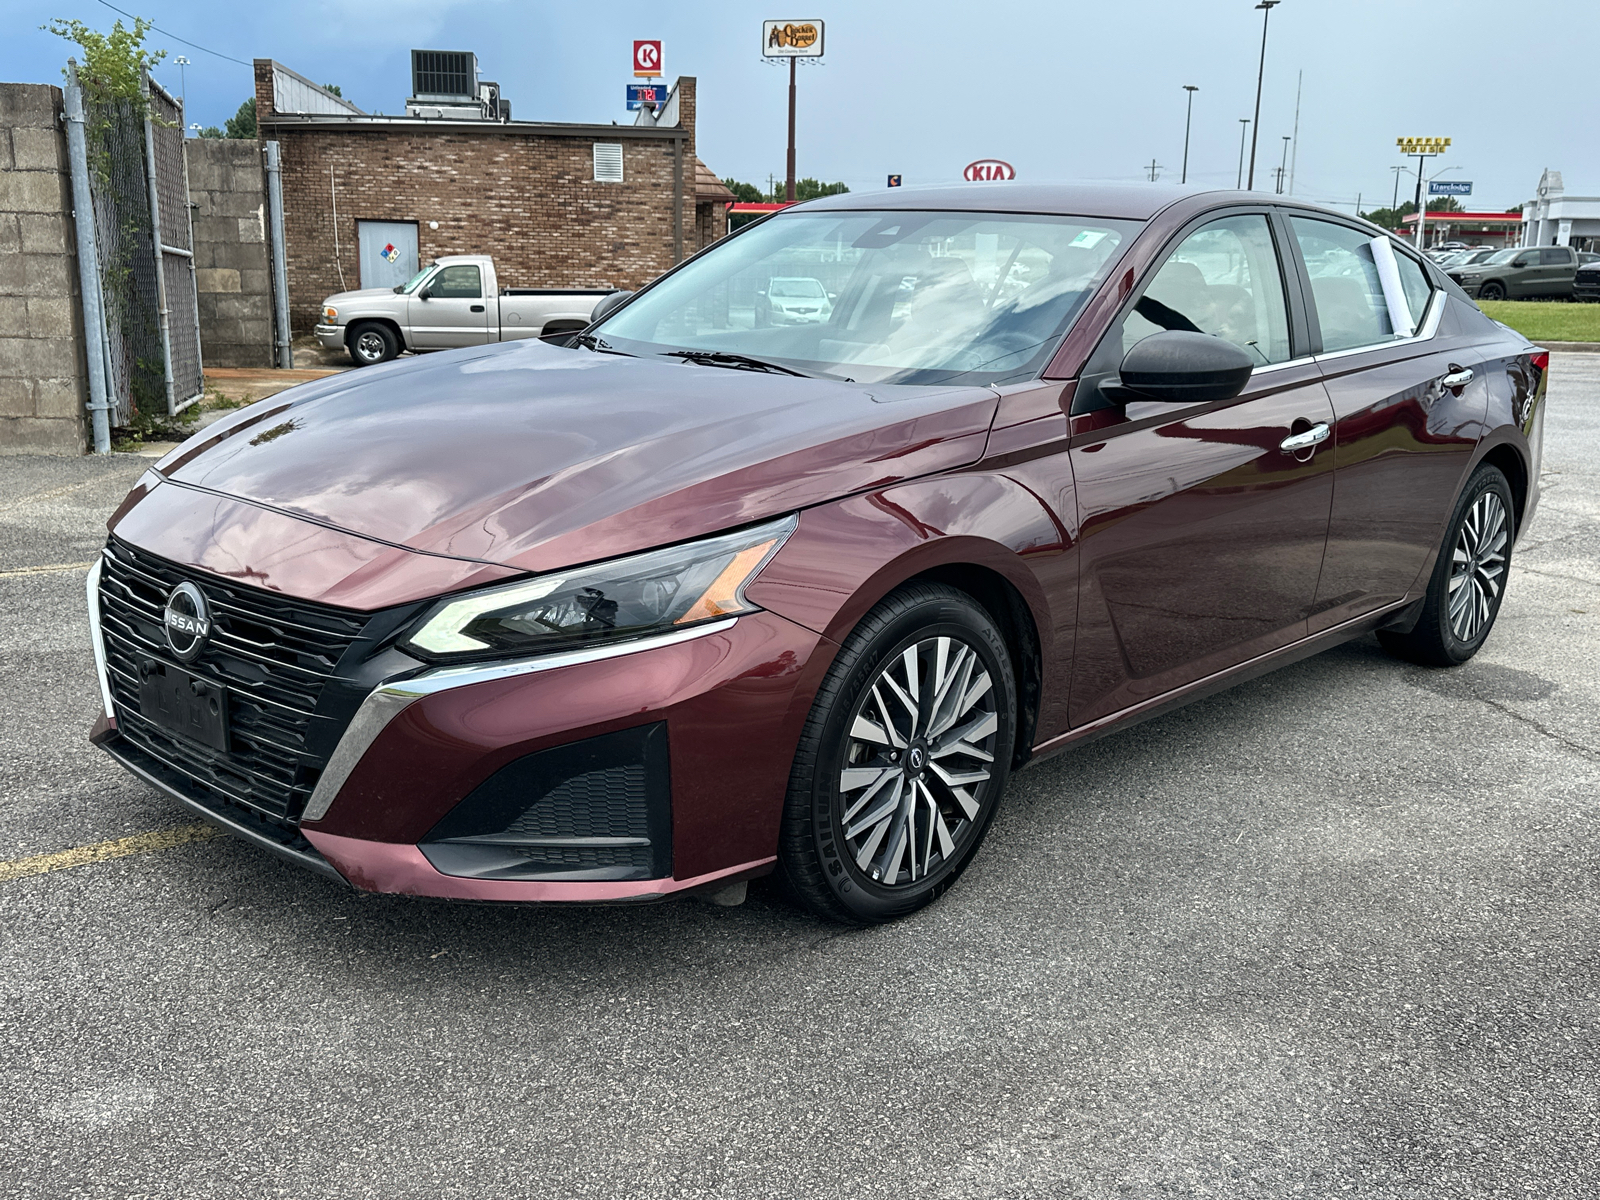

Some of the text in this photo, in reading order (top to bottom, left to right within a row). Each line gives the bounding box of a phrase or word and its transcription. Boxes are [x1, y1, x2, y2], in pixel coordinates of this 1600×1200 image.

[972, 165, 1005, 181] KIA
[1432, 183, 1470, 192] Travelodge
[981, 627, 1016, 715] ATREZZO
[818, 771, 843, 877] SAILUN
